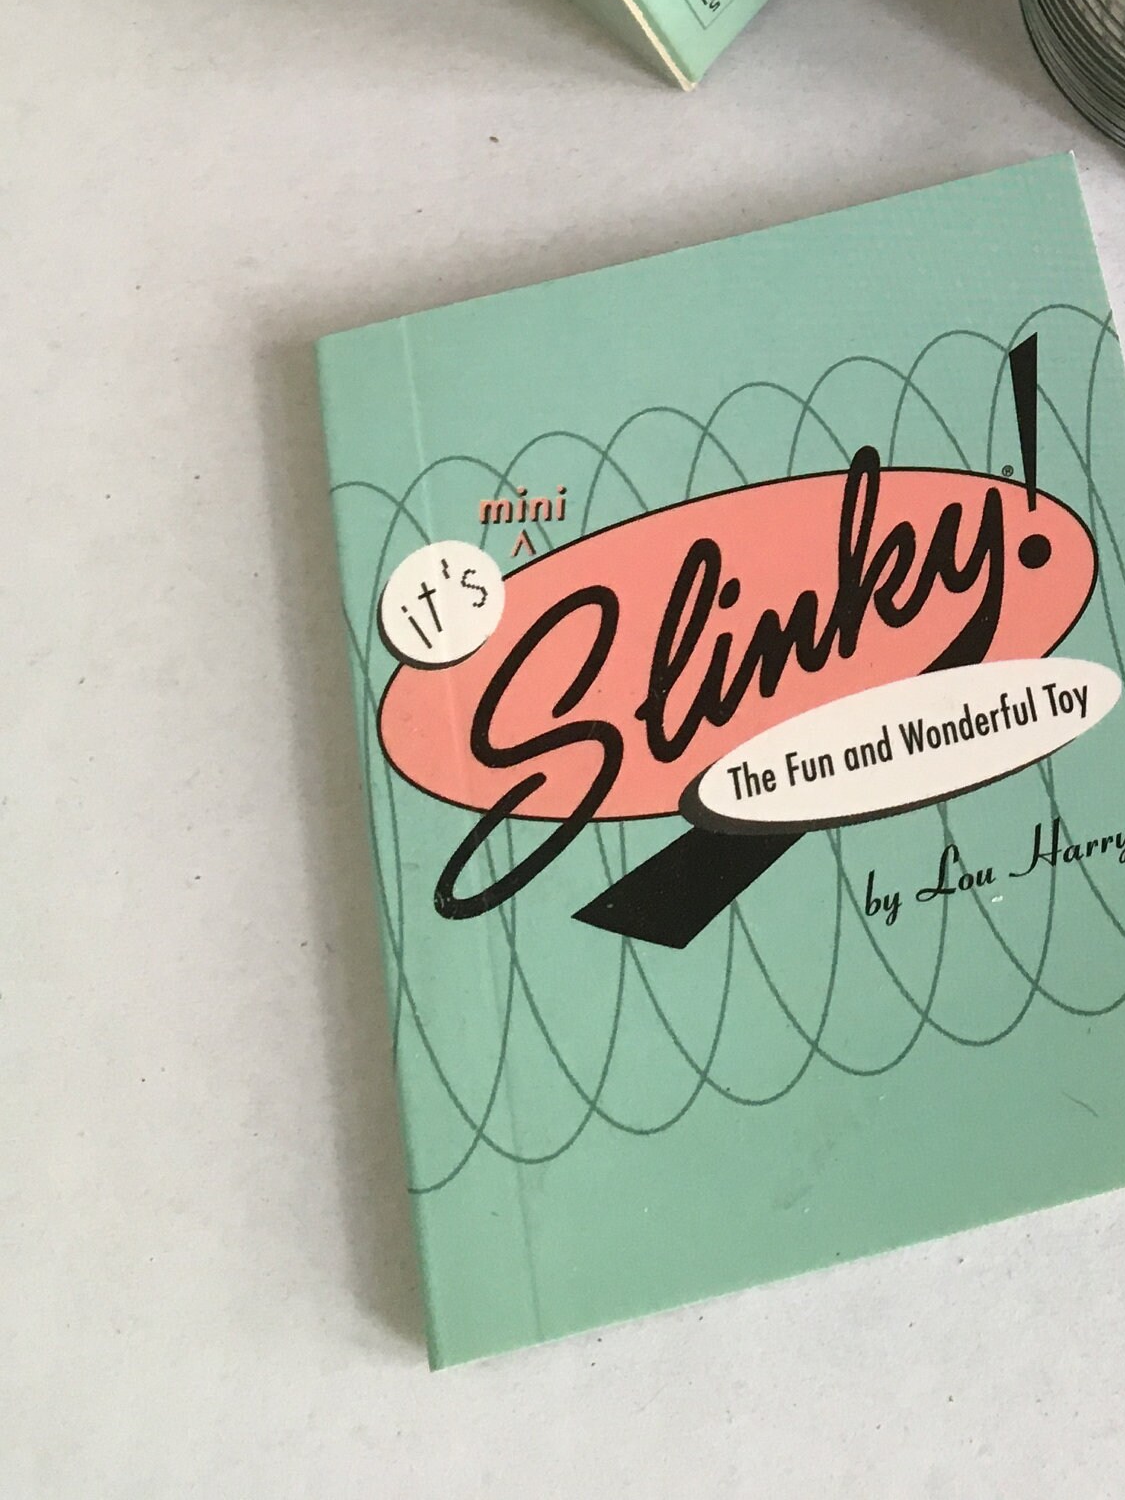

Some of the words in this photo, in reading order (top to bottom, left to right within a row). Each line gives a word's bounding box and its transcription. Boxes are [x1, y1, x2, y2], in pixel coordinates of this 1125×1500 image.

[479, 485, 567, 524] mini
[401, 558, 488, 649] it's
[727, 760, 777, 801] The
[785, 751, 835, 787] Fun
[844, 725, 894, 772] and
[899, 692, 1038, 757] Wonderful
[1042, 682, 1090, 719] Toy
[863, 870, 902, 927] by
[915, 844, 997, 902] Lou
